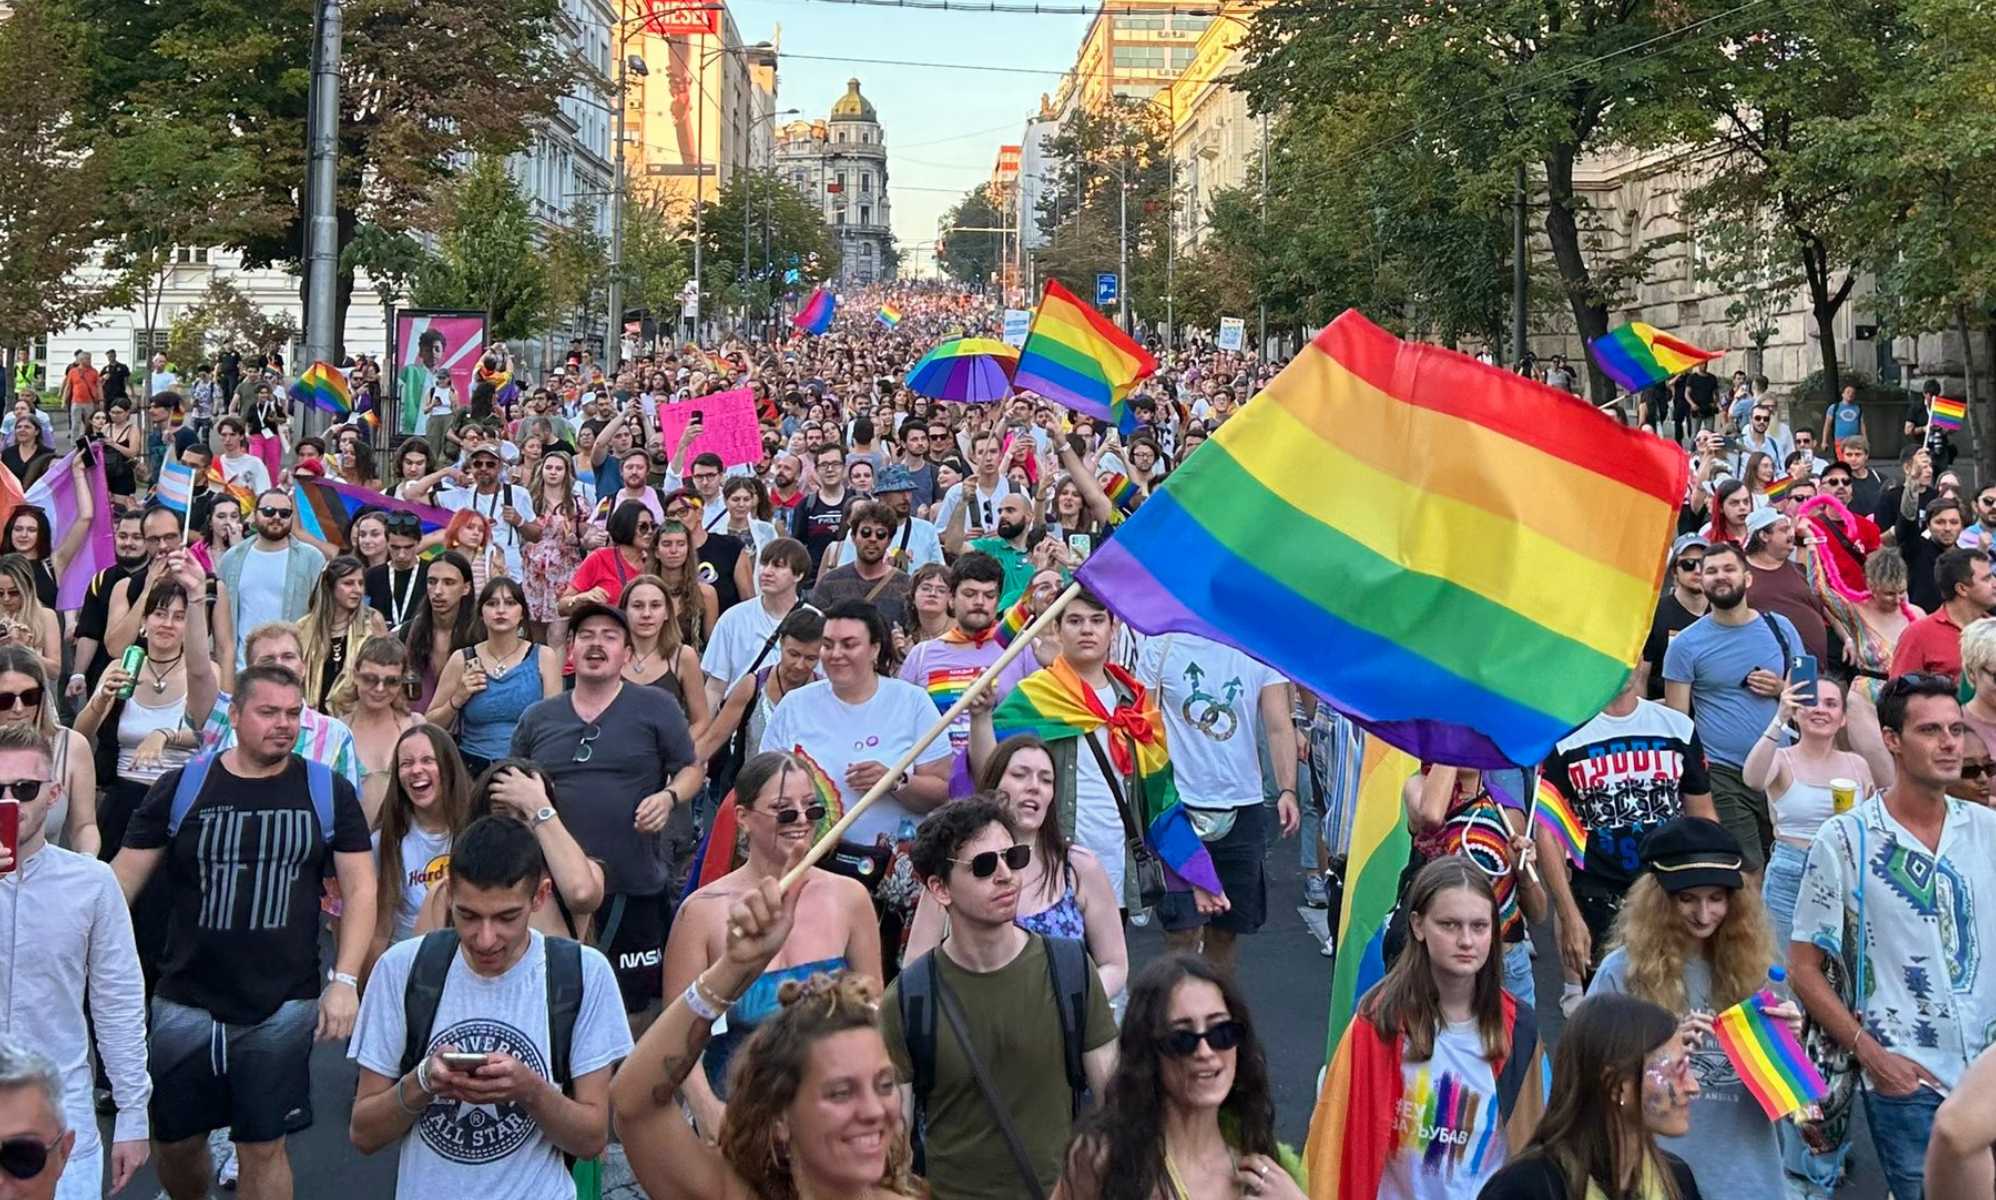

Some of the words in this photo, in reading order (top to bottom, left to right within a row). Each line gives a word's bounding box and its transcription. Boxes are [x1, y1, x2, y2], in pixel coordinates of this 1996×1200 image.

[652, 1, 709, 25] DIESEL
[409, 864, 443, 887] Hard
[430, 1113, 464, 1145] ALL
[472, 1112, 523, 1147] STAR
